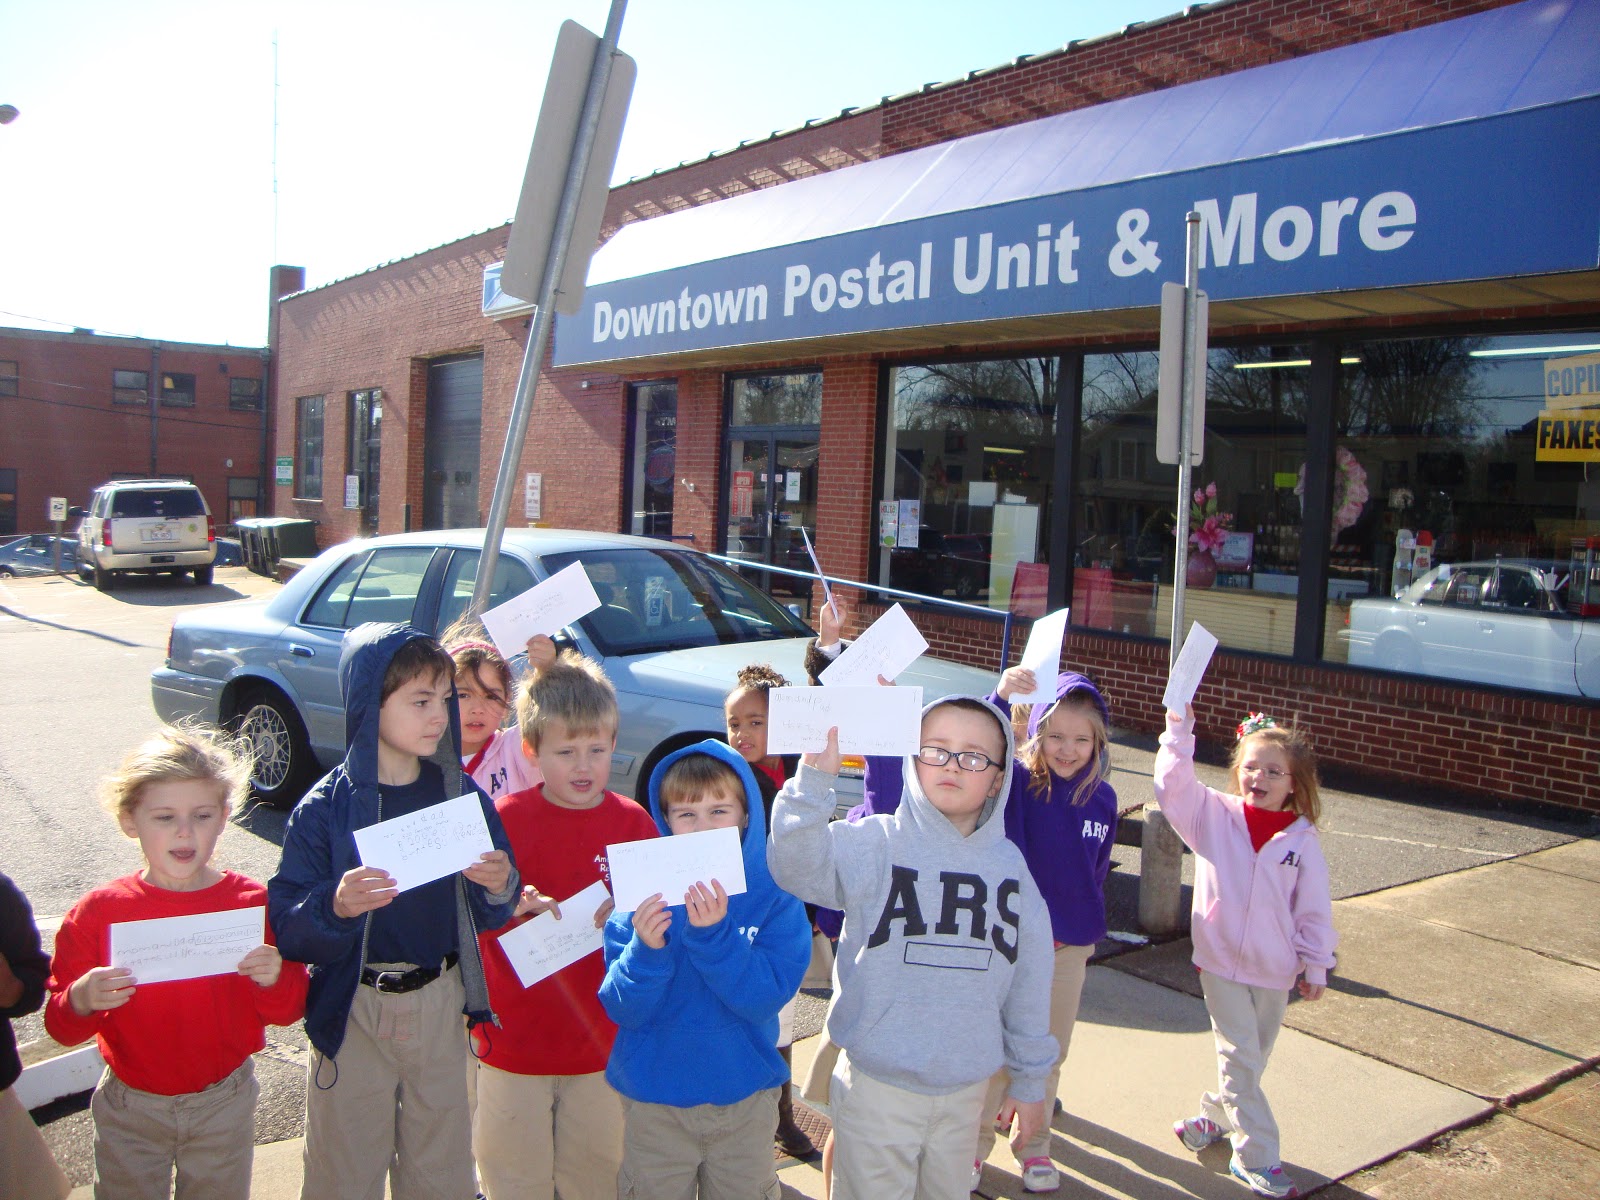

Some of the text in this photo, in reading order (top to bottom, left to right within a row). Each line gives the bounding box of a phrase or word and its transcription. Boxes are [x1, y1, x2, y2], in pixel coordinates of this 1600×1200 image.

[593, 190, 1417, 343] Downtown Postal Unit & More
[1082, 819, 1109, 843] ARS
[1280, 850, 1301, 867] A
[867, 864, 1020, 964] ARS
